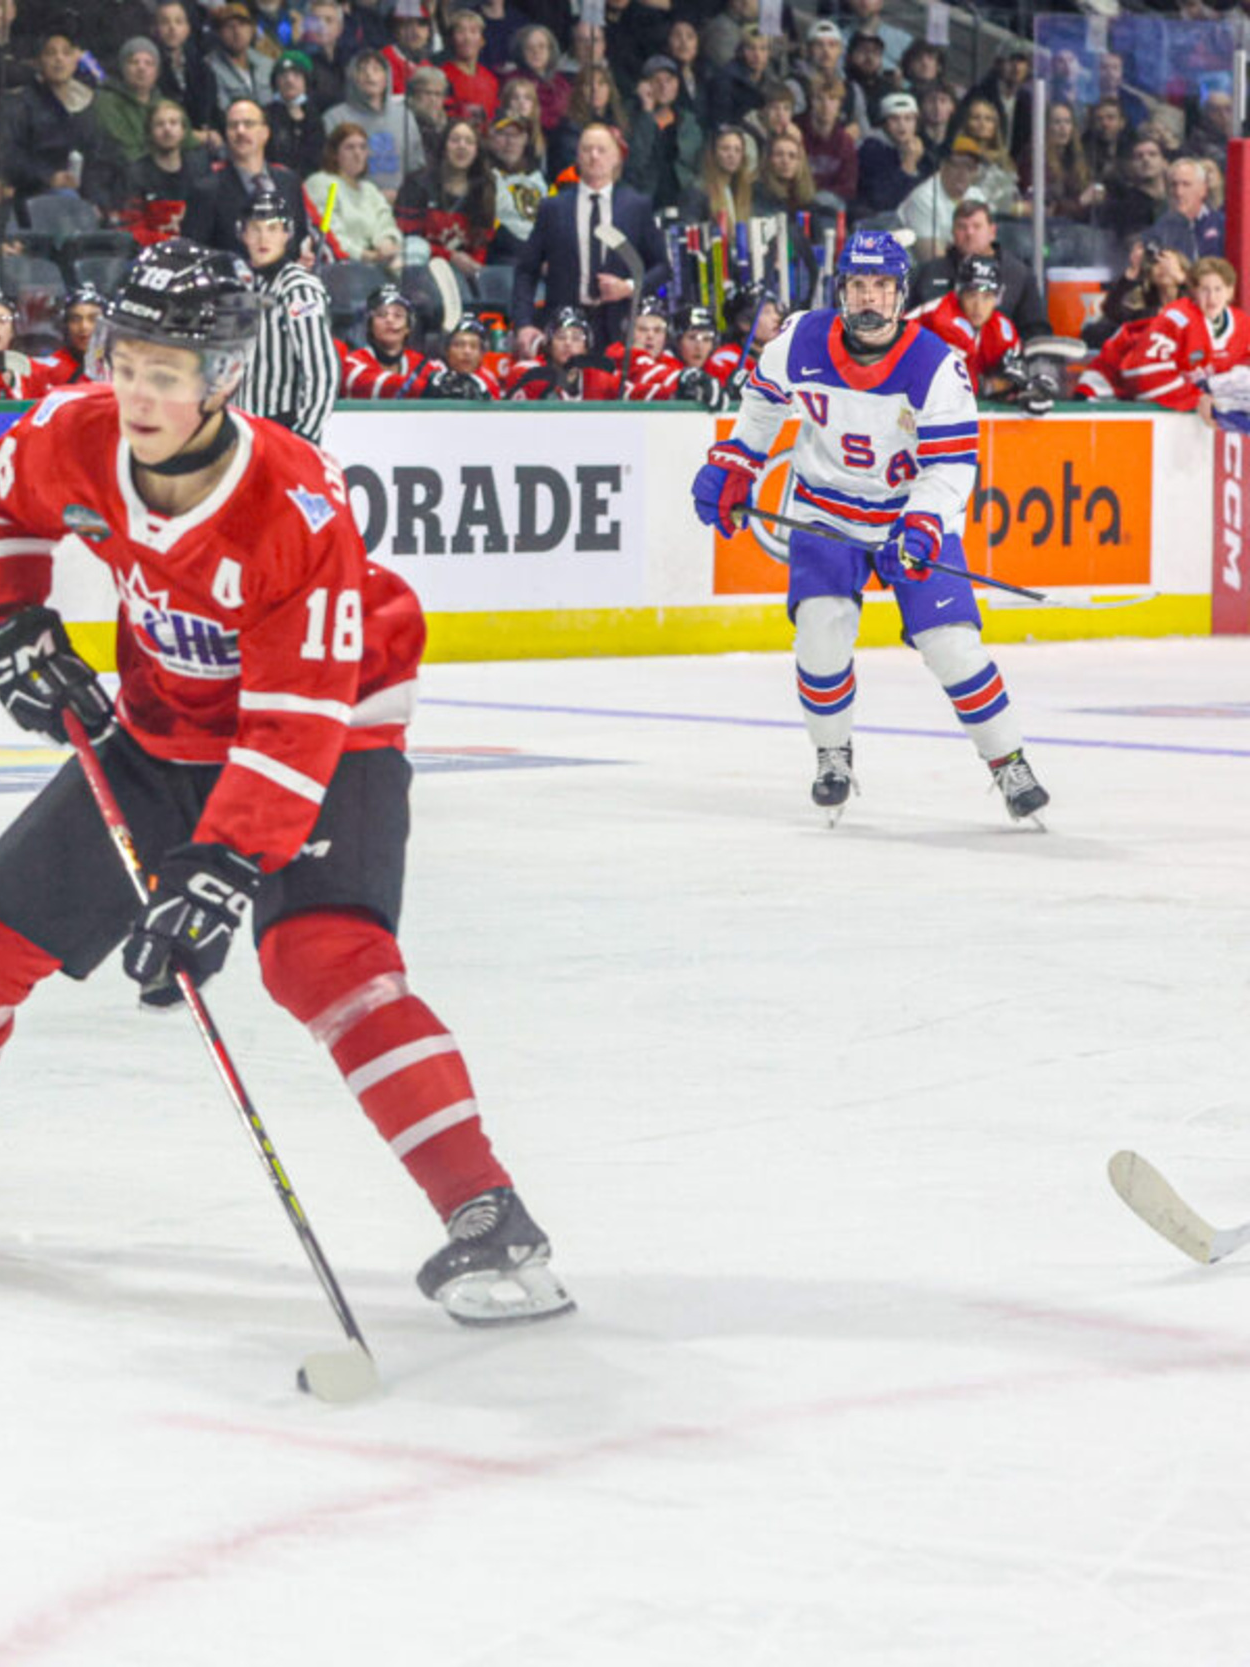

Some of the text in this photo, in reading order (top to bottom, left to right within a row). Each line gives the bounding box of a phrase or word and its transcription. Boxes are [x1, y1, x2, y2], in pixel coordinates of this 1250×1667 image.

[138, 265, 174, 290] 18
[344, 464, 621, 555] ORADE
[973, 460, 1121, 547] bota
[1223, 433, 1242, 591] CCM
[211, 556, 244, 609] A
[143, 610, 240, 666] CHL
[301, 588, 363, 661] 18
